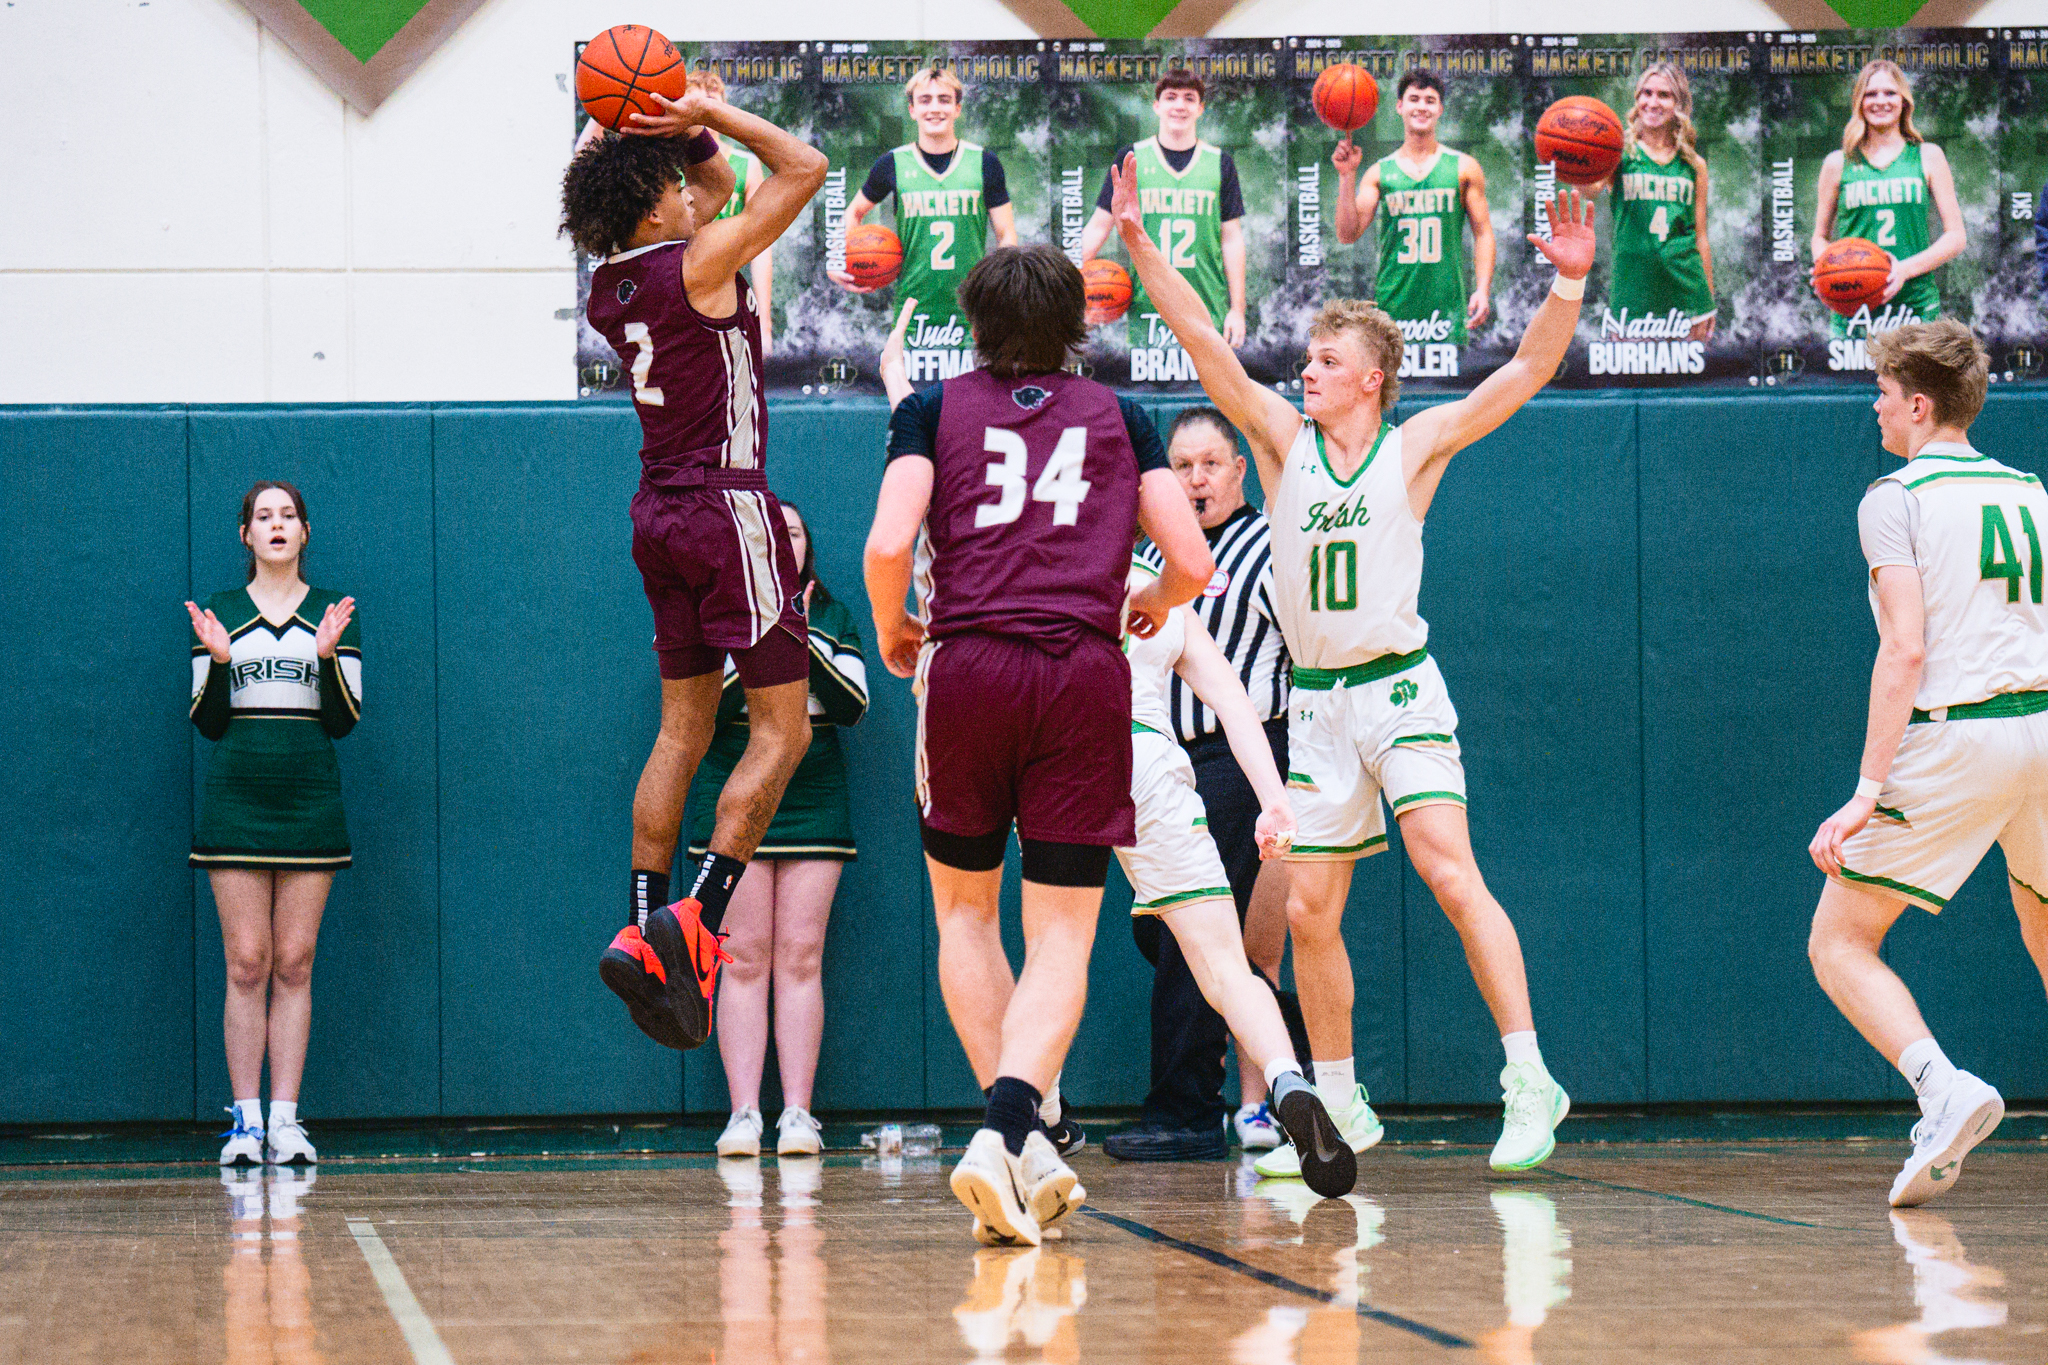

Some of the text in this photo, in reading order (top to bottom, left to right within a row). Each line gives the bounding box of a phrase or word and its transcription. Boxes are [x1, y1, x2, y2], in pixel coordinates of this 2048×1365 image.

[693, 55, 803, 84] CATHOLIC
[822, 54, 1040, 83] HACKETT CATHOLIC
[1058, 53, 1276, 82] HACKETT CATHOLIC
[1403, 48, 1513, 77] CATHOLIC
[1532, 46, 1750, 77] HACKETT CATHOLIC
[1770, 42, 1990, 74] HACKETT CATHOLIC
[901, 190, 981, 218] HACKETT
[1140, 188, 1216, 216] HACKETT
[1385, 187, 1456, 217] HACKETT
[1622, 173, 1695, 203] HACKETT
[1845, 177, 1923, 210] HACKETT
[825, 167, 847, 271] BASKETBALL
[1298, 162, 1320, 266] BASKETBALL
[1535, 160, 1556, 265] BSKETBALL
[1773, 157, 1794, 262] BASKETBALL
[2011, 191, 2033, 220] SKI
[1397, 217, 1442, 264] 30
[1650, 206, 1670, 242] 4
[1876, 209, 1897, 246] 2
[930, 221, 956, 270] 2
[1159, 218, 1196, 268] 12
[907, 314, 965, 348] Jude
[1395, 309, 1451, 341] rooks
[1601, 307, 1692, 339] Natalie
[1397, 343, 1459, 377] SLER
[1589, 341, 1705, 375] BURHANS
[974, 426, 1092, 528] 34
[1978, 503, 2044, 605] 41
[1309, 539, 1359, 613] 10
[230, 656, 320, 692] IRISH
